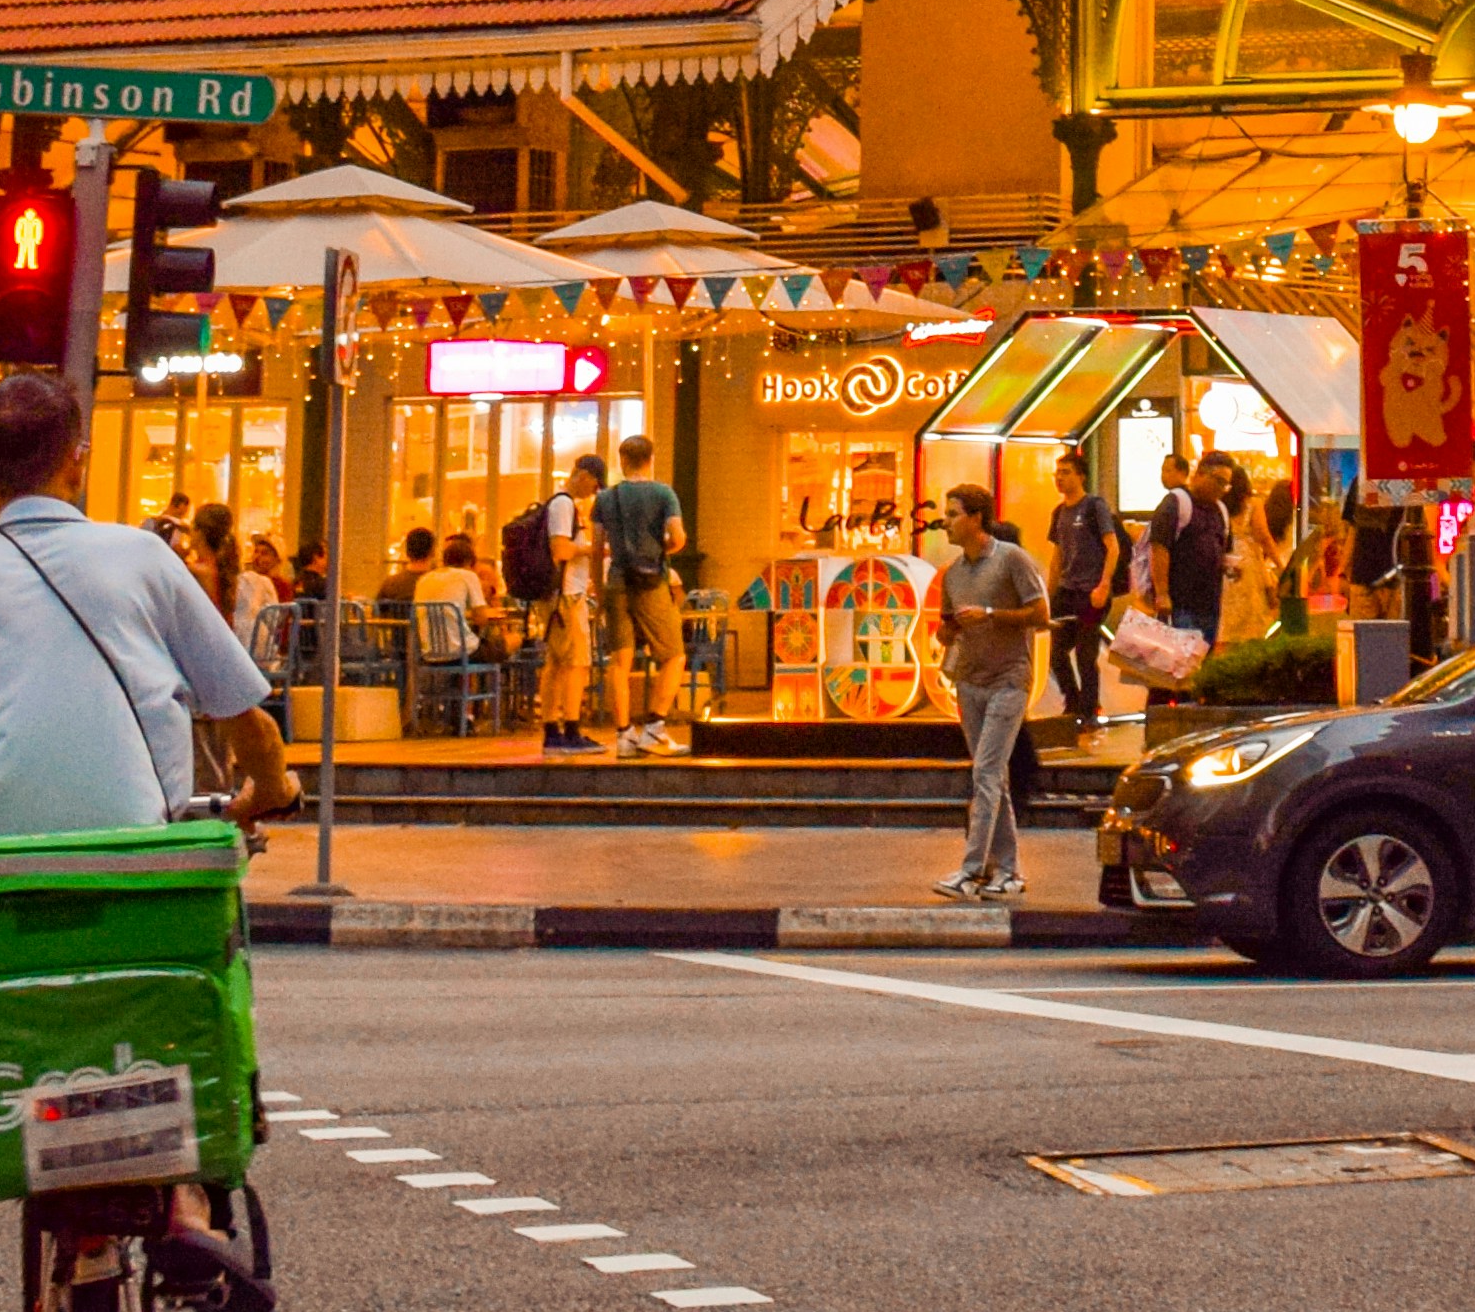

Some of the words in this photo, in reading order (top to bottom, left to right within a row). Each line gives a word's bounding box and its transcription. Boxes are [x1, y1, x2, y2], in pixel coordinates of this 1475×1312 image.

[197, 78, 253, 117] Rd
[761, 371, 840, 403] Hook
[800, 496, 867, 534] Lau
[910, 498, 947, 536] Sa
